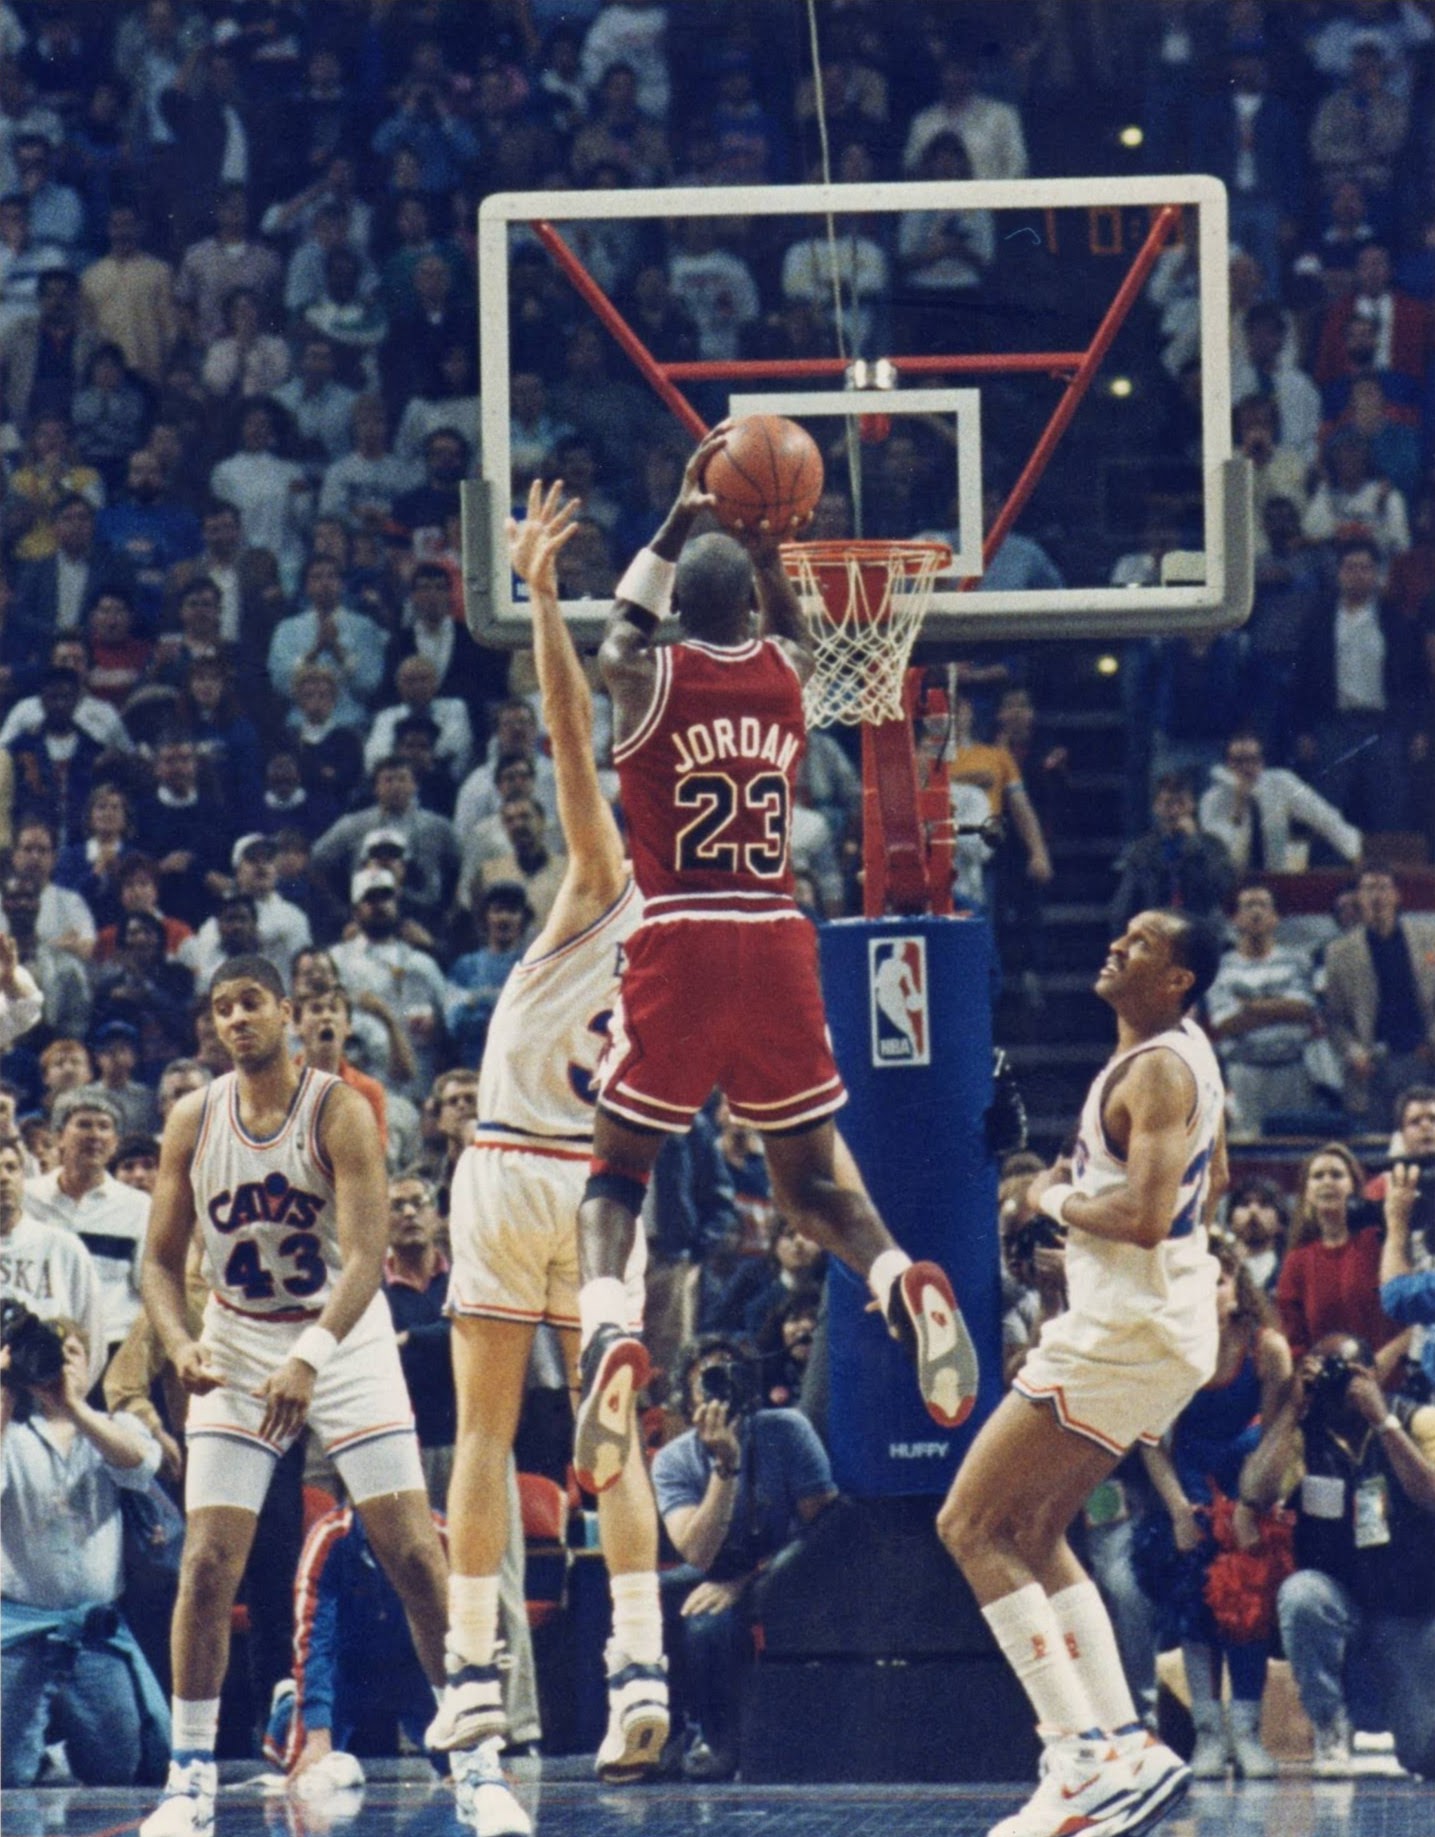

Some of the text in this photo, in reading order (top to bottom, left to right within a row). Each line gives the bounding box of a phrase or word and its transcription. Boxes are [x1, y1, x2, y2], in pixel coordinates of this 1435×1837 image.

[672, 716, 799, 773] JORDAN
[674, 771, 790, 879] 23
[208, 1172, 327, 1234] CAVS
[224, 1232, 328, 1300] 43
[889, 1442, 949, 1458] HUFFY
